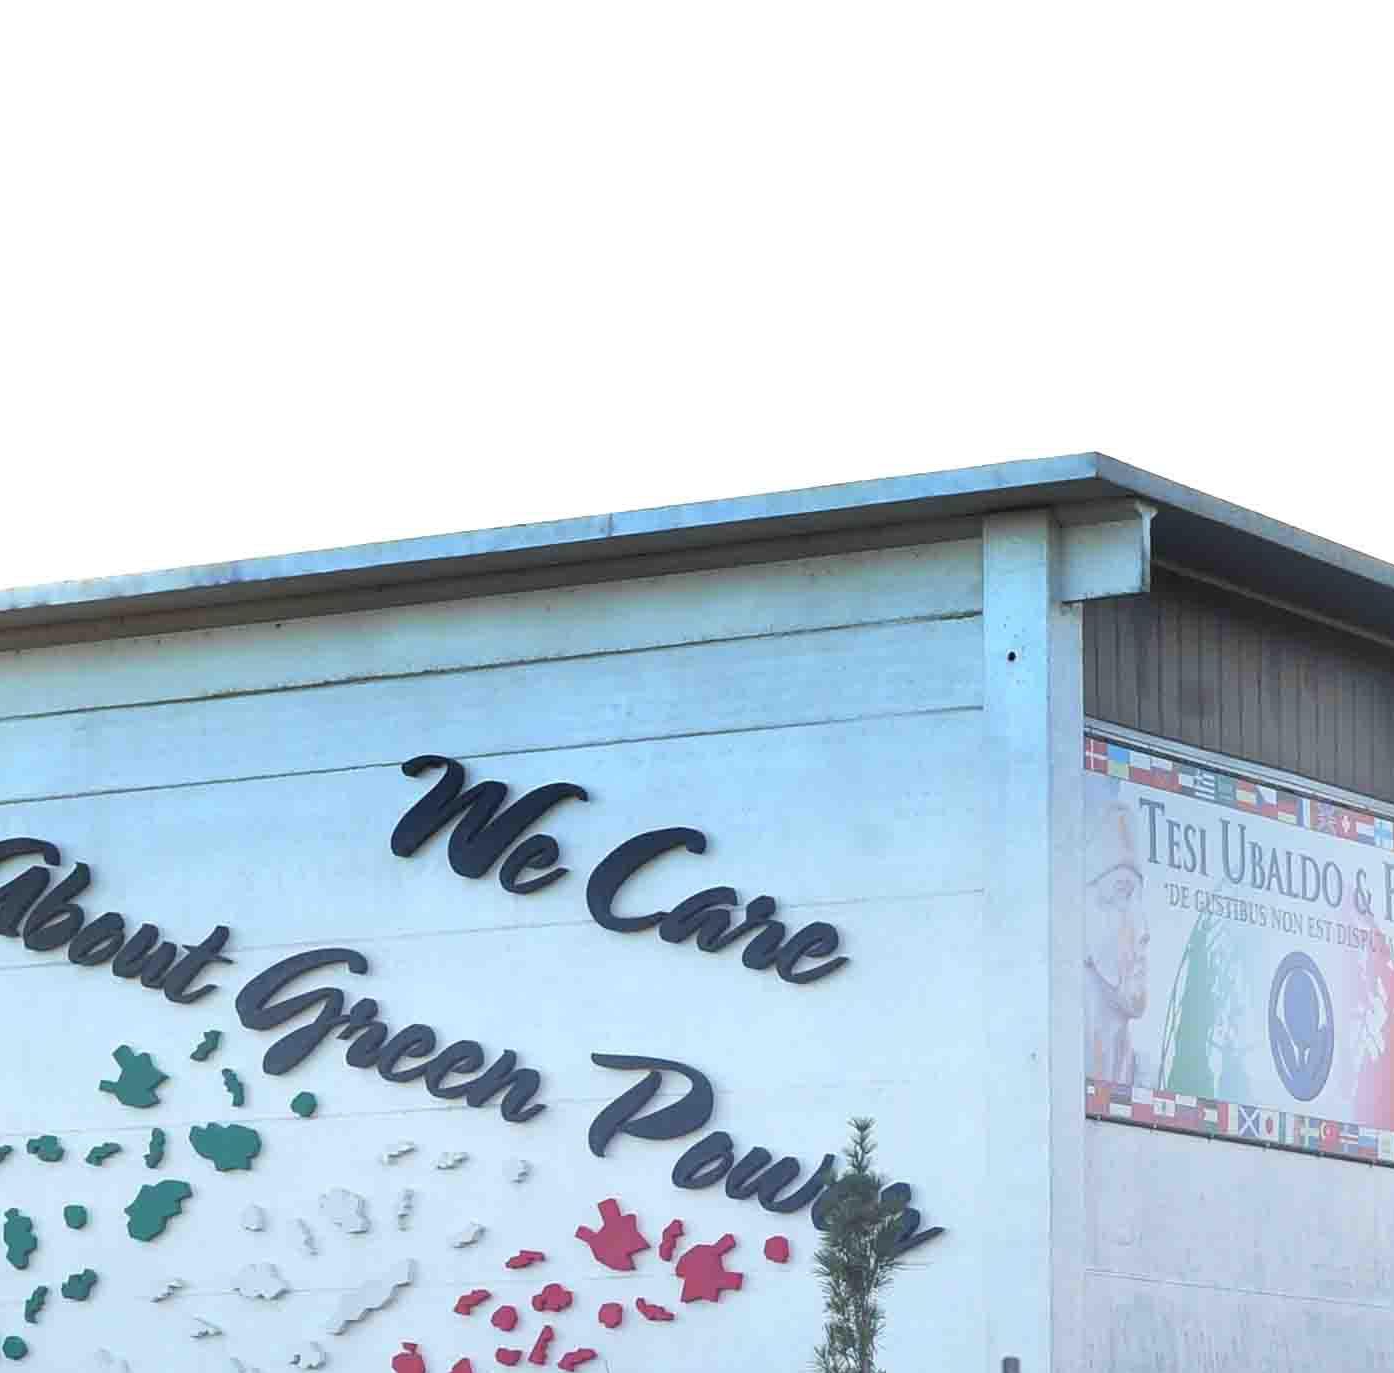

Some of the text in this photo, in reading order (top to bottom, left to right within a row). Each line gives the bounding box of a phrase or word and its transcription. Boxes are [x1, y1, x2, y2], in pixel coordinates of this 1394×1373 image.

[391, 754, 850, 986] We Care
[1355, 867, 1375, 917] &
[235, 947, 547, 1123] Green
